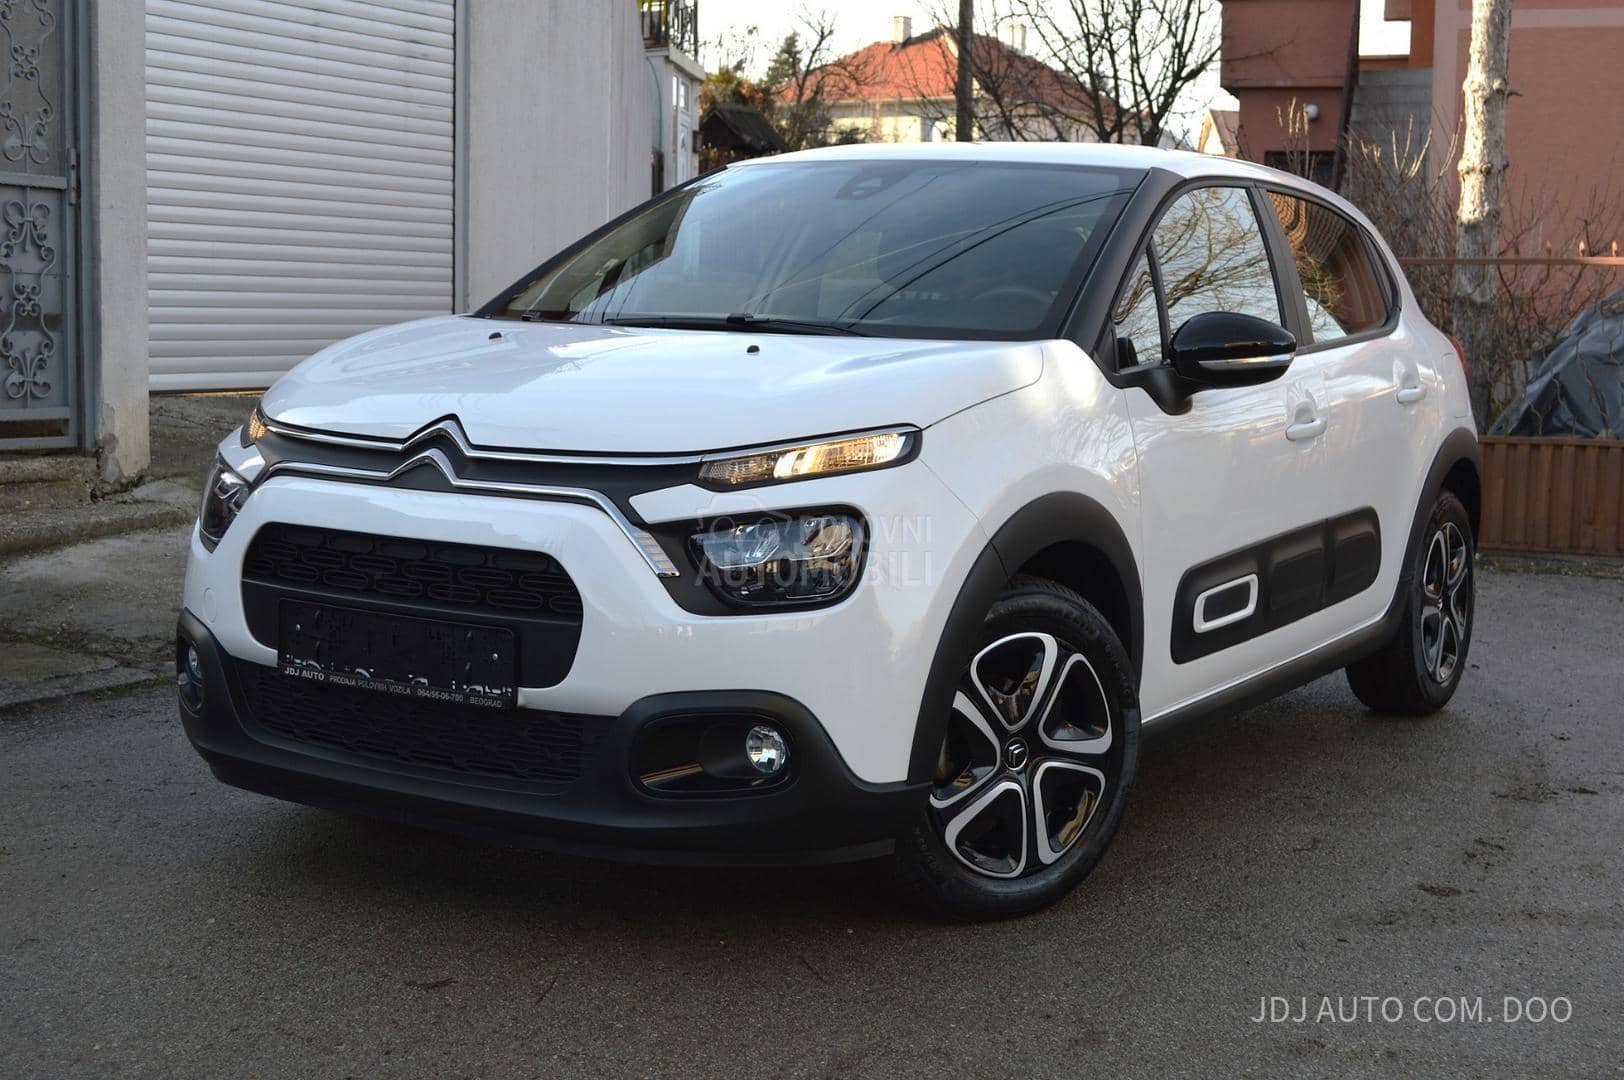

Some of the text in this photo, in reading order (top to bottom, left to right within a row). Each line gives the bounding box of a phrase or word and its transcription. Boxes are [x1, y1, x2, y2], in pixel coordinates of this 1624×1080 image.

[285, 667, 300, 677] JDJ
[301, 670, 325, 681] AUTO
[469, 696, 503, 708] BEOGRAD
